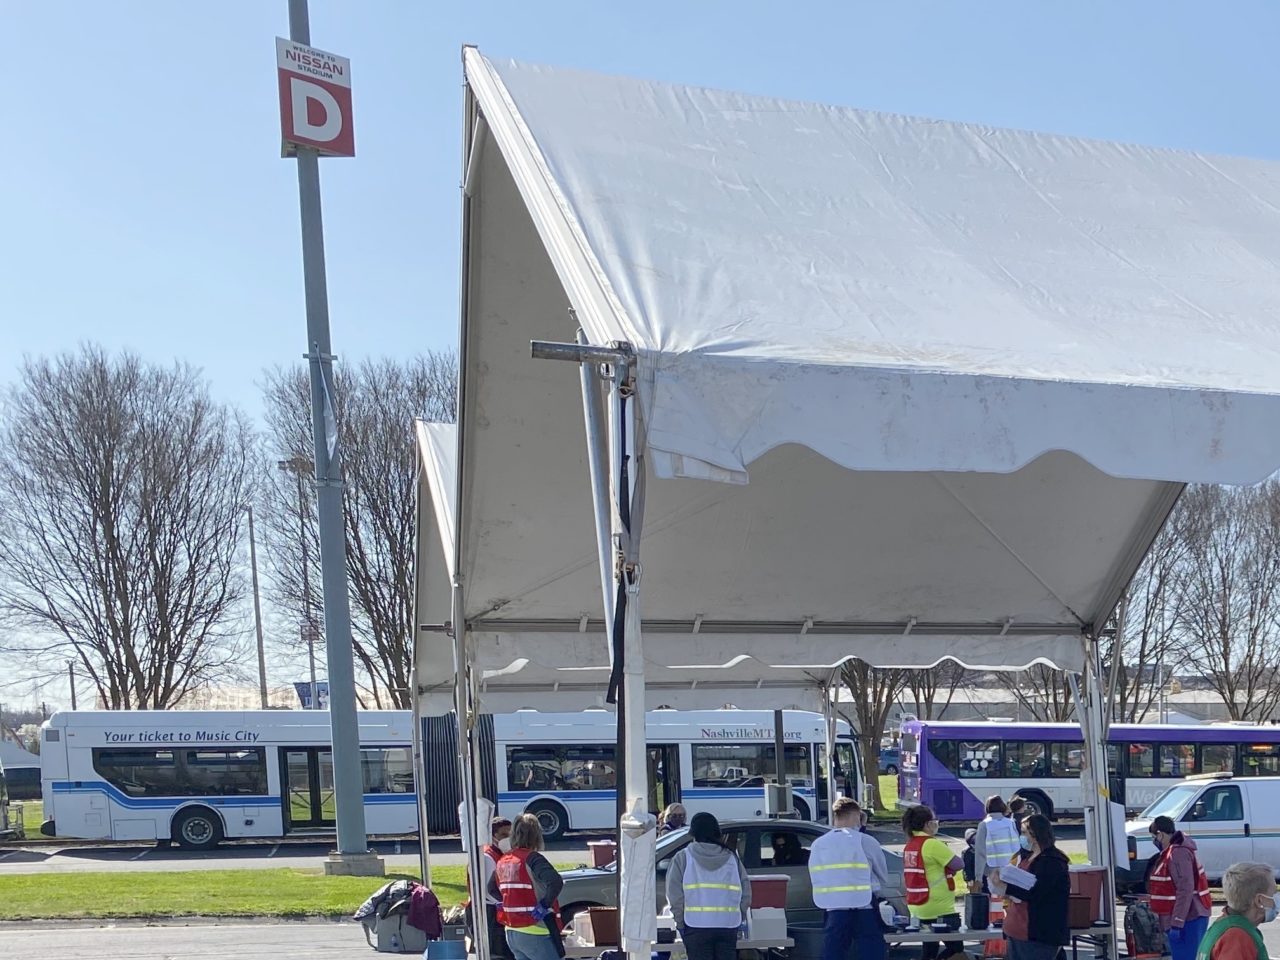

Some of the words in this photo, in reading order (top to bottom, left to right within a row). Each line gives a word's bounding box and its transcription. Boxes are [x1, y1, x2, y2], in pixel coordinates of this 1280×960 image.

[293, 46, 325, 59] WELCOME
[285, 49, 343, 76] NISSAN
[297, 64, 333, 79] STADIUM
[290, 77, 343, 142] D
[104, 731, 134, 742] Your
[139, 730, 173, 742] ticket
[179, 731, 191, 741] to
[195, 730, 230, 742] Music
[235, 730, 259, 743] City
[701, 728, 802, 740] NashvilleMT.org
